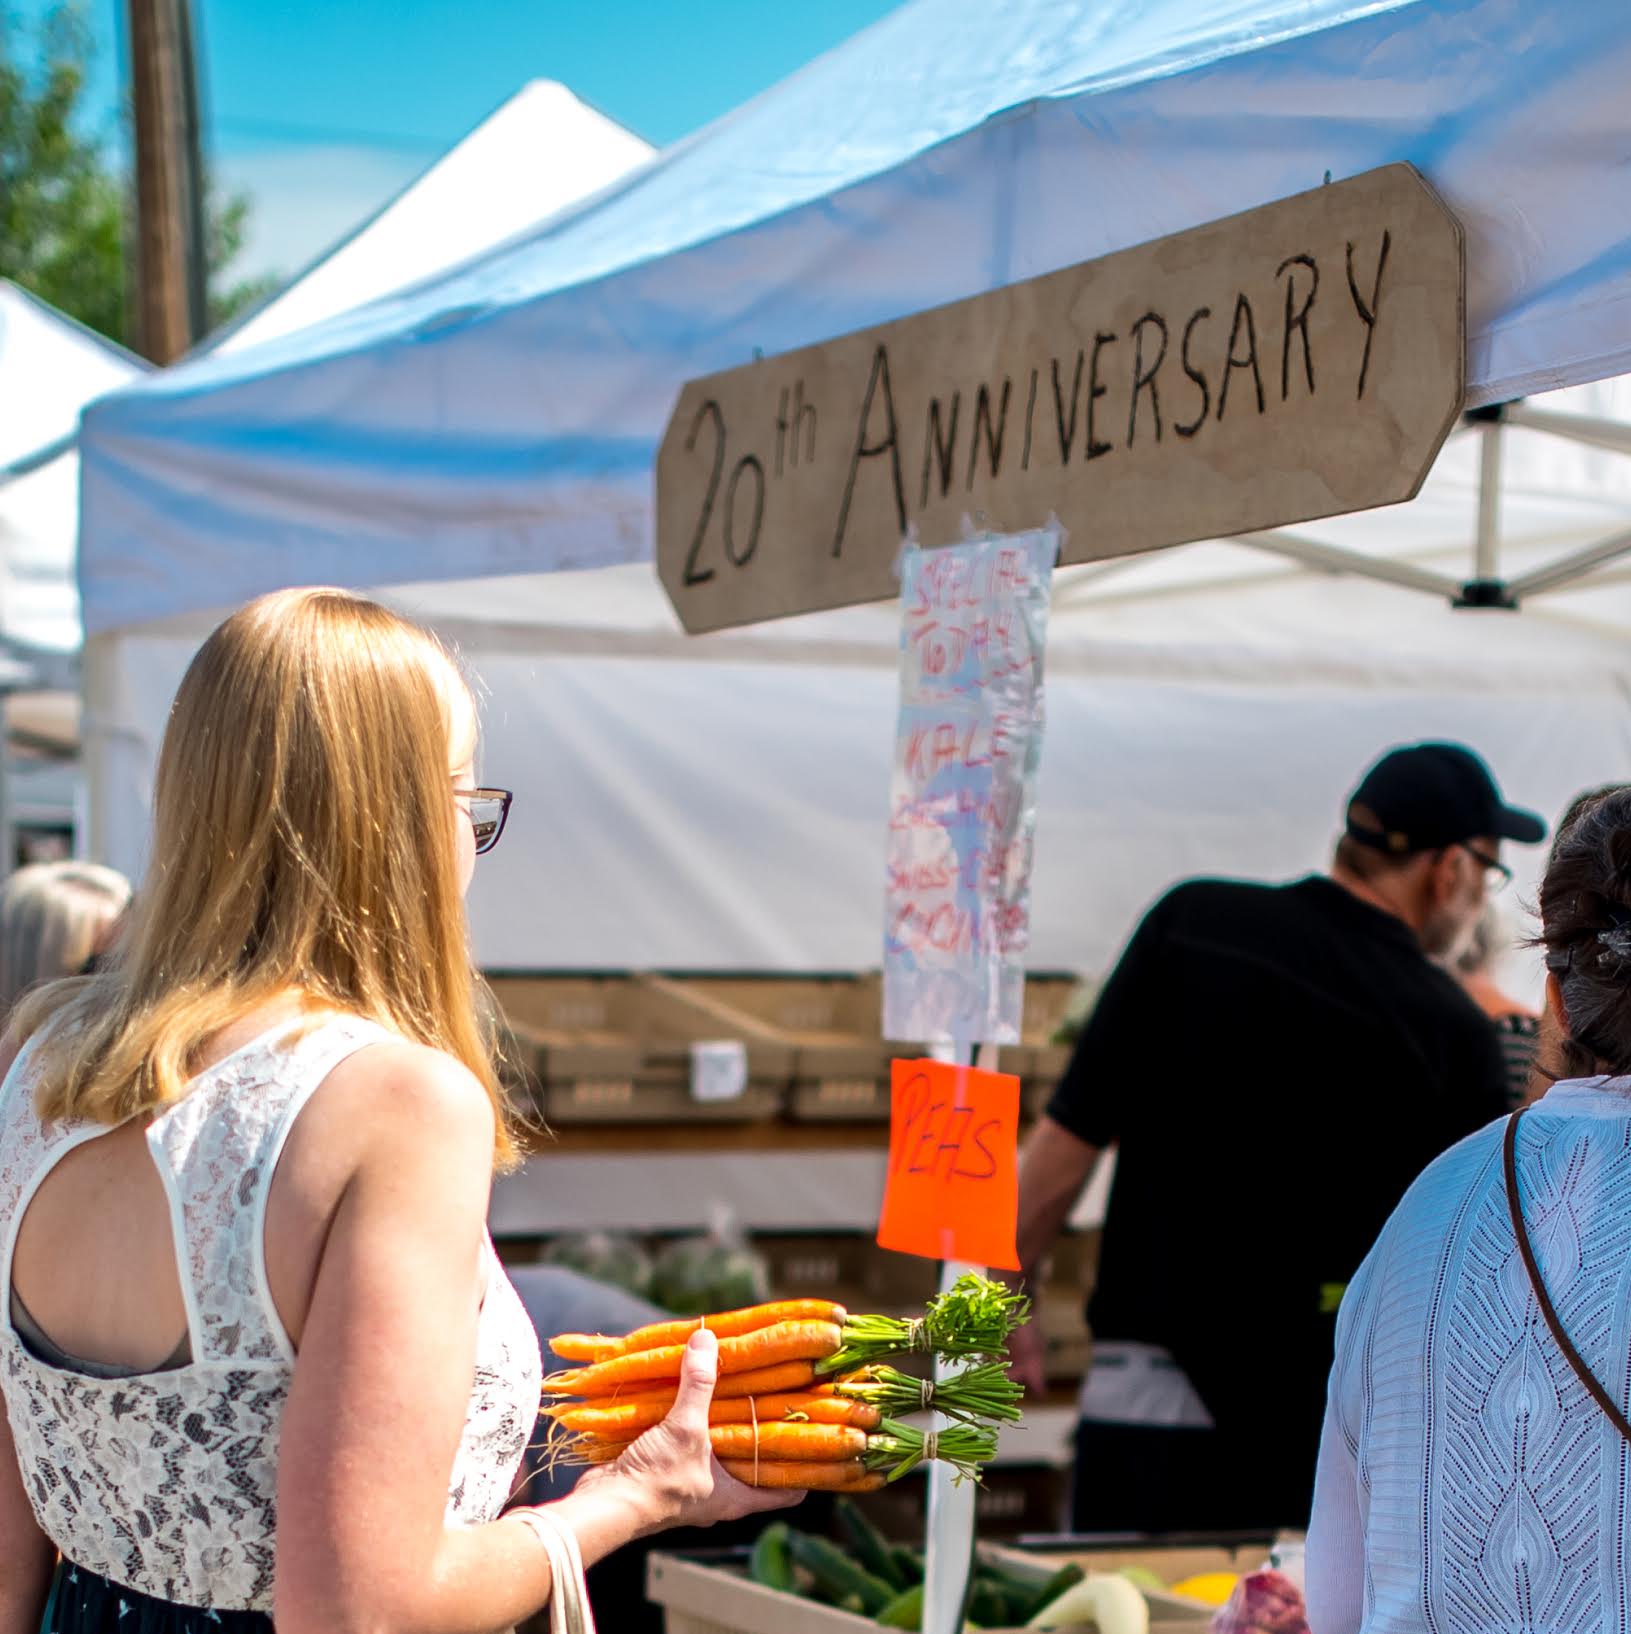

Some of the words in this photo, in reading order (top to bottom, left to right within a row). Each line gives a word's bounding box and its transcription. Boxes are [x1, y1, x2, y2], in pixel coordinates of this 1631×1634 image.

[681, 378, 818, 588] 20th
[830, 228, 1393, 560] ANNIVERSARY
[892, 1072, 1004, 1183] PEAS
